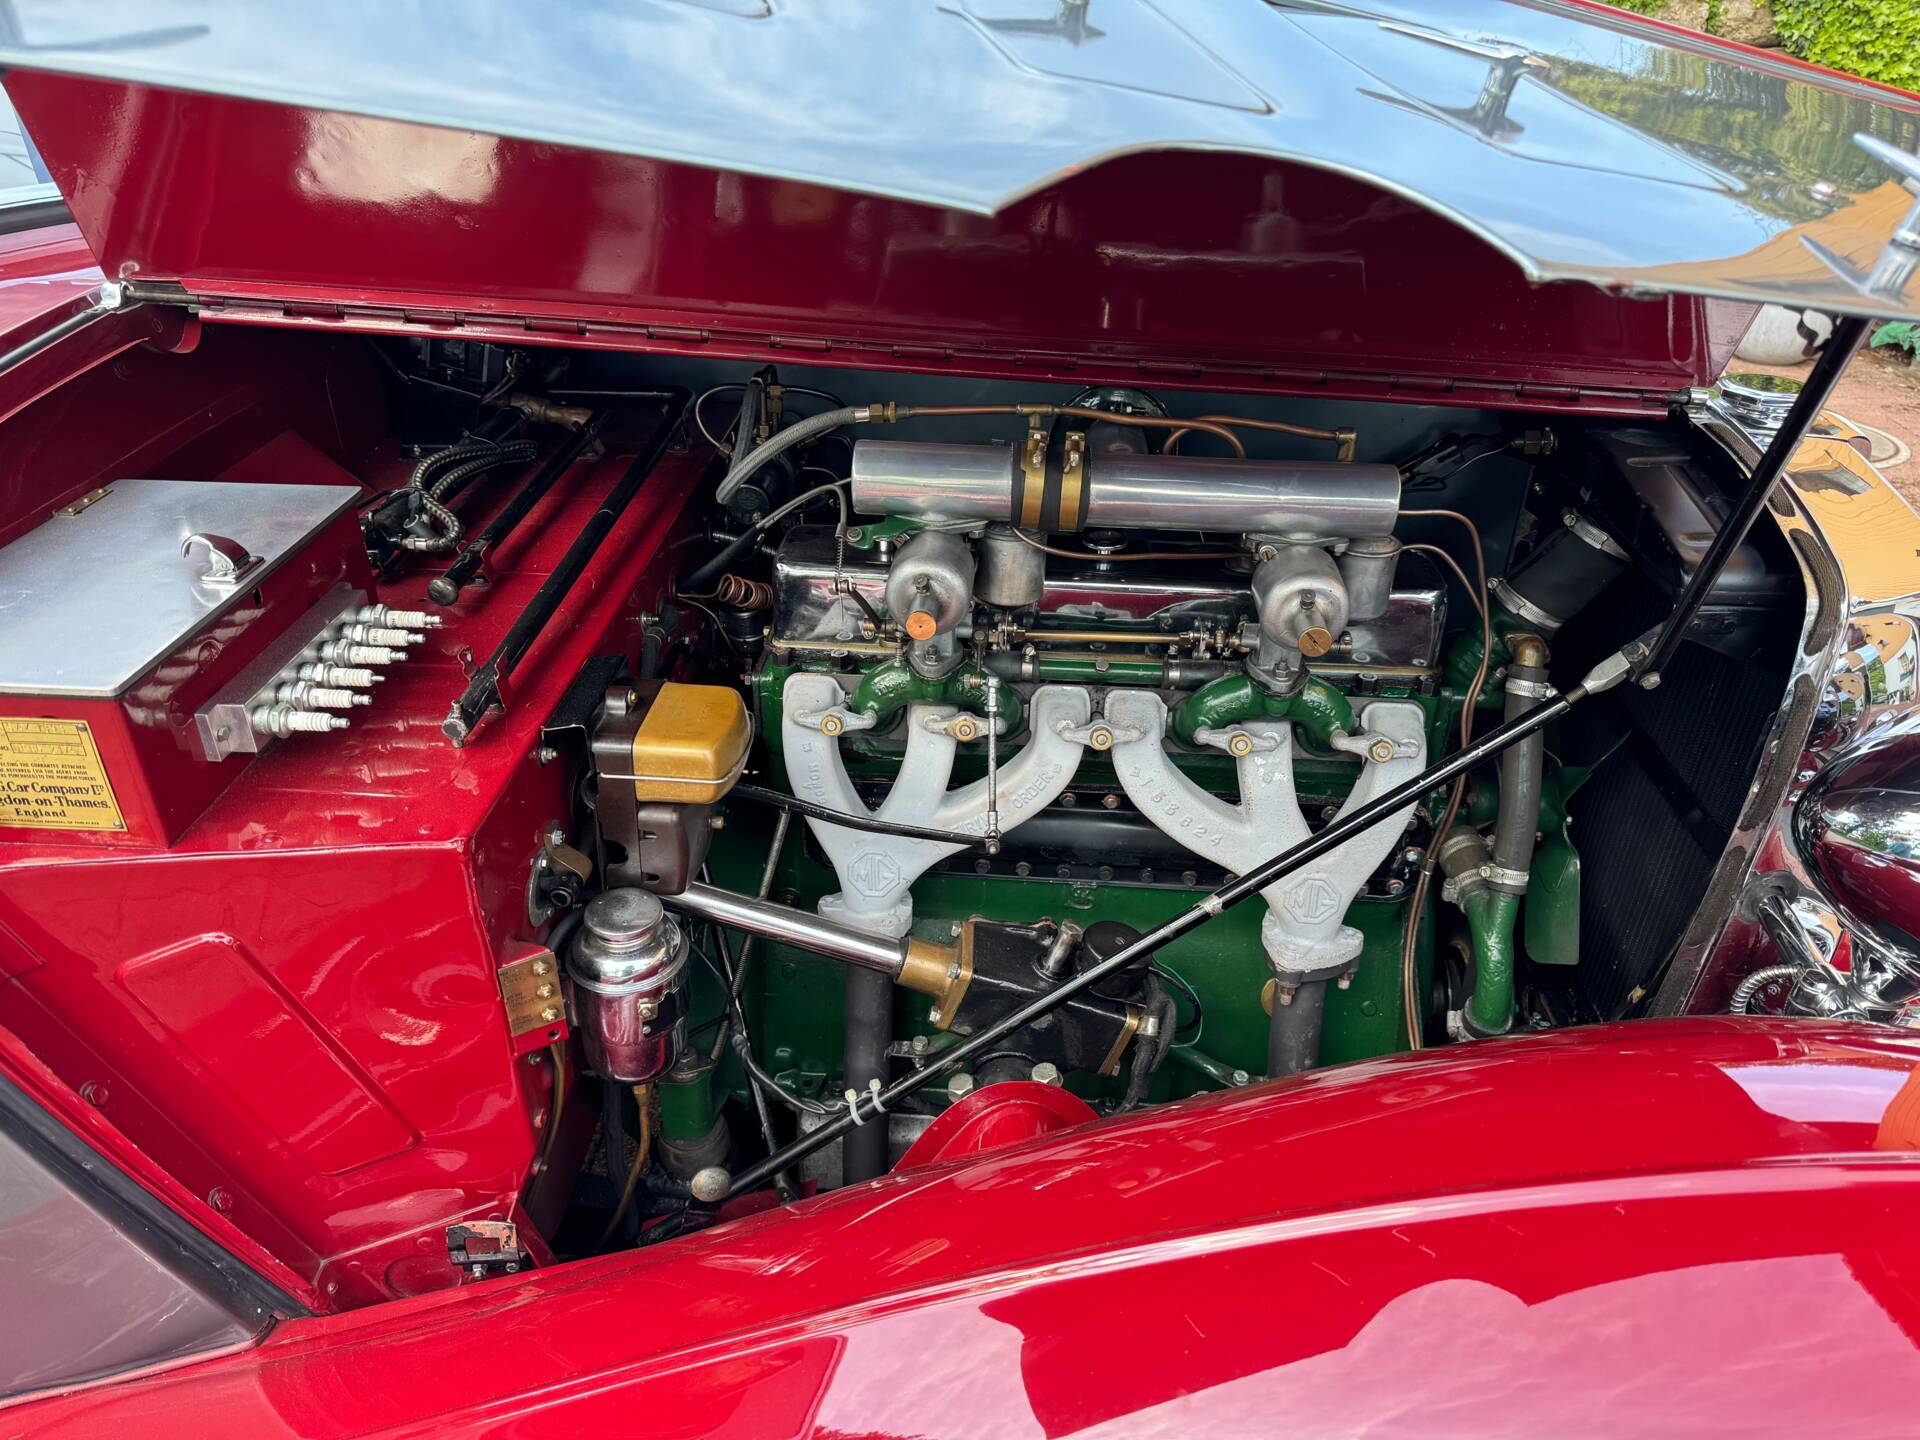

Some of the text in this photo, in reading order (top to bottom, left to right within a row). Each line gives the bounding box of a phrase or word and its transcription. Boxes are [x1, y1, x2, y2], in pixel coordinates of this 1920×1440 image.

[7, 781, 30, 793] Car
[31, 781, 90, 795] Company
[1012, 769, 1055, 809] ORDER
[15, 807, 67, 818] England
